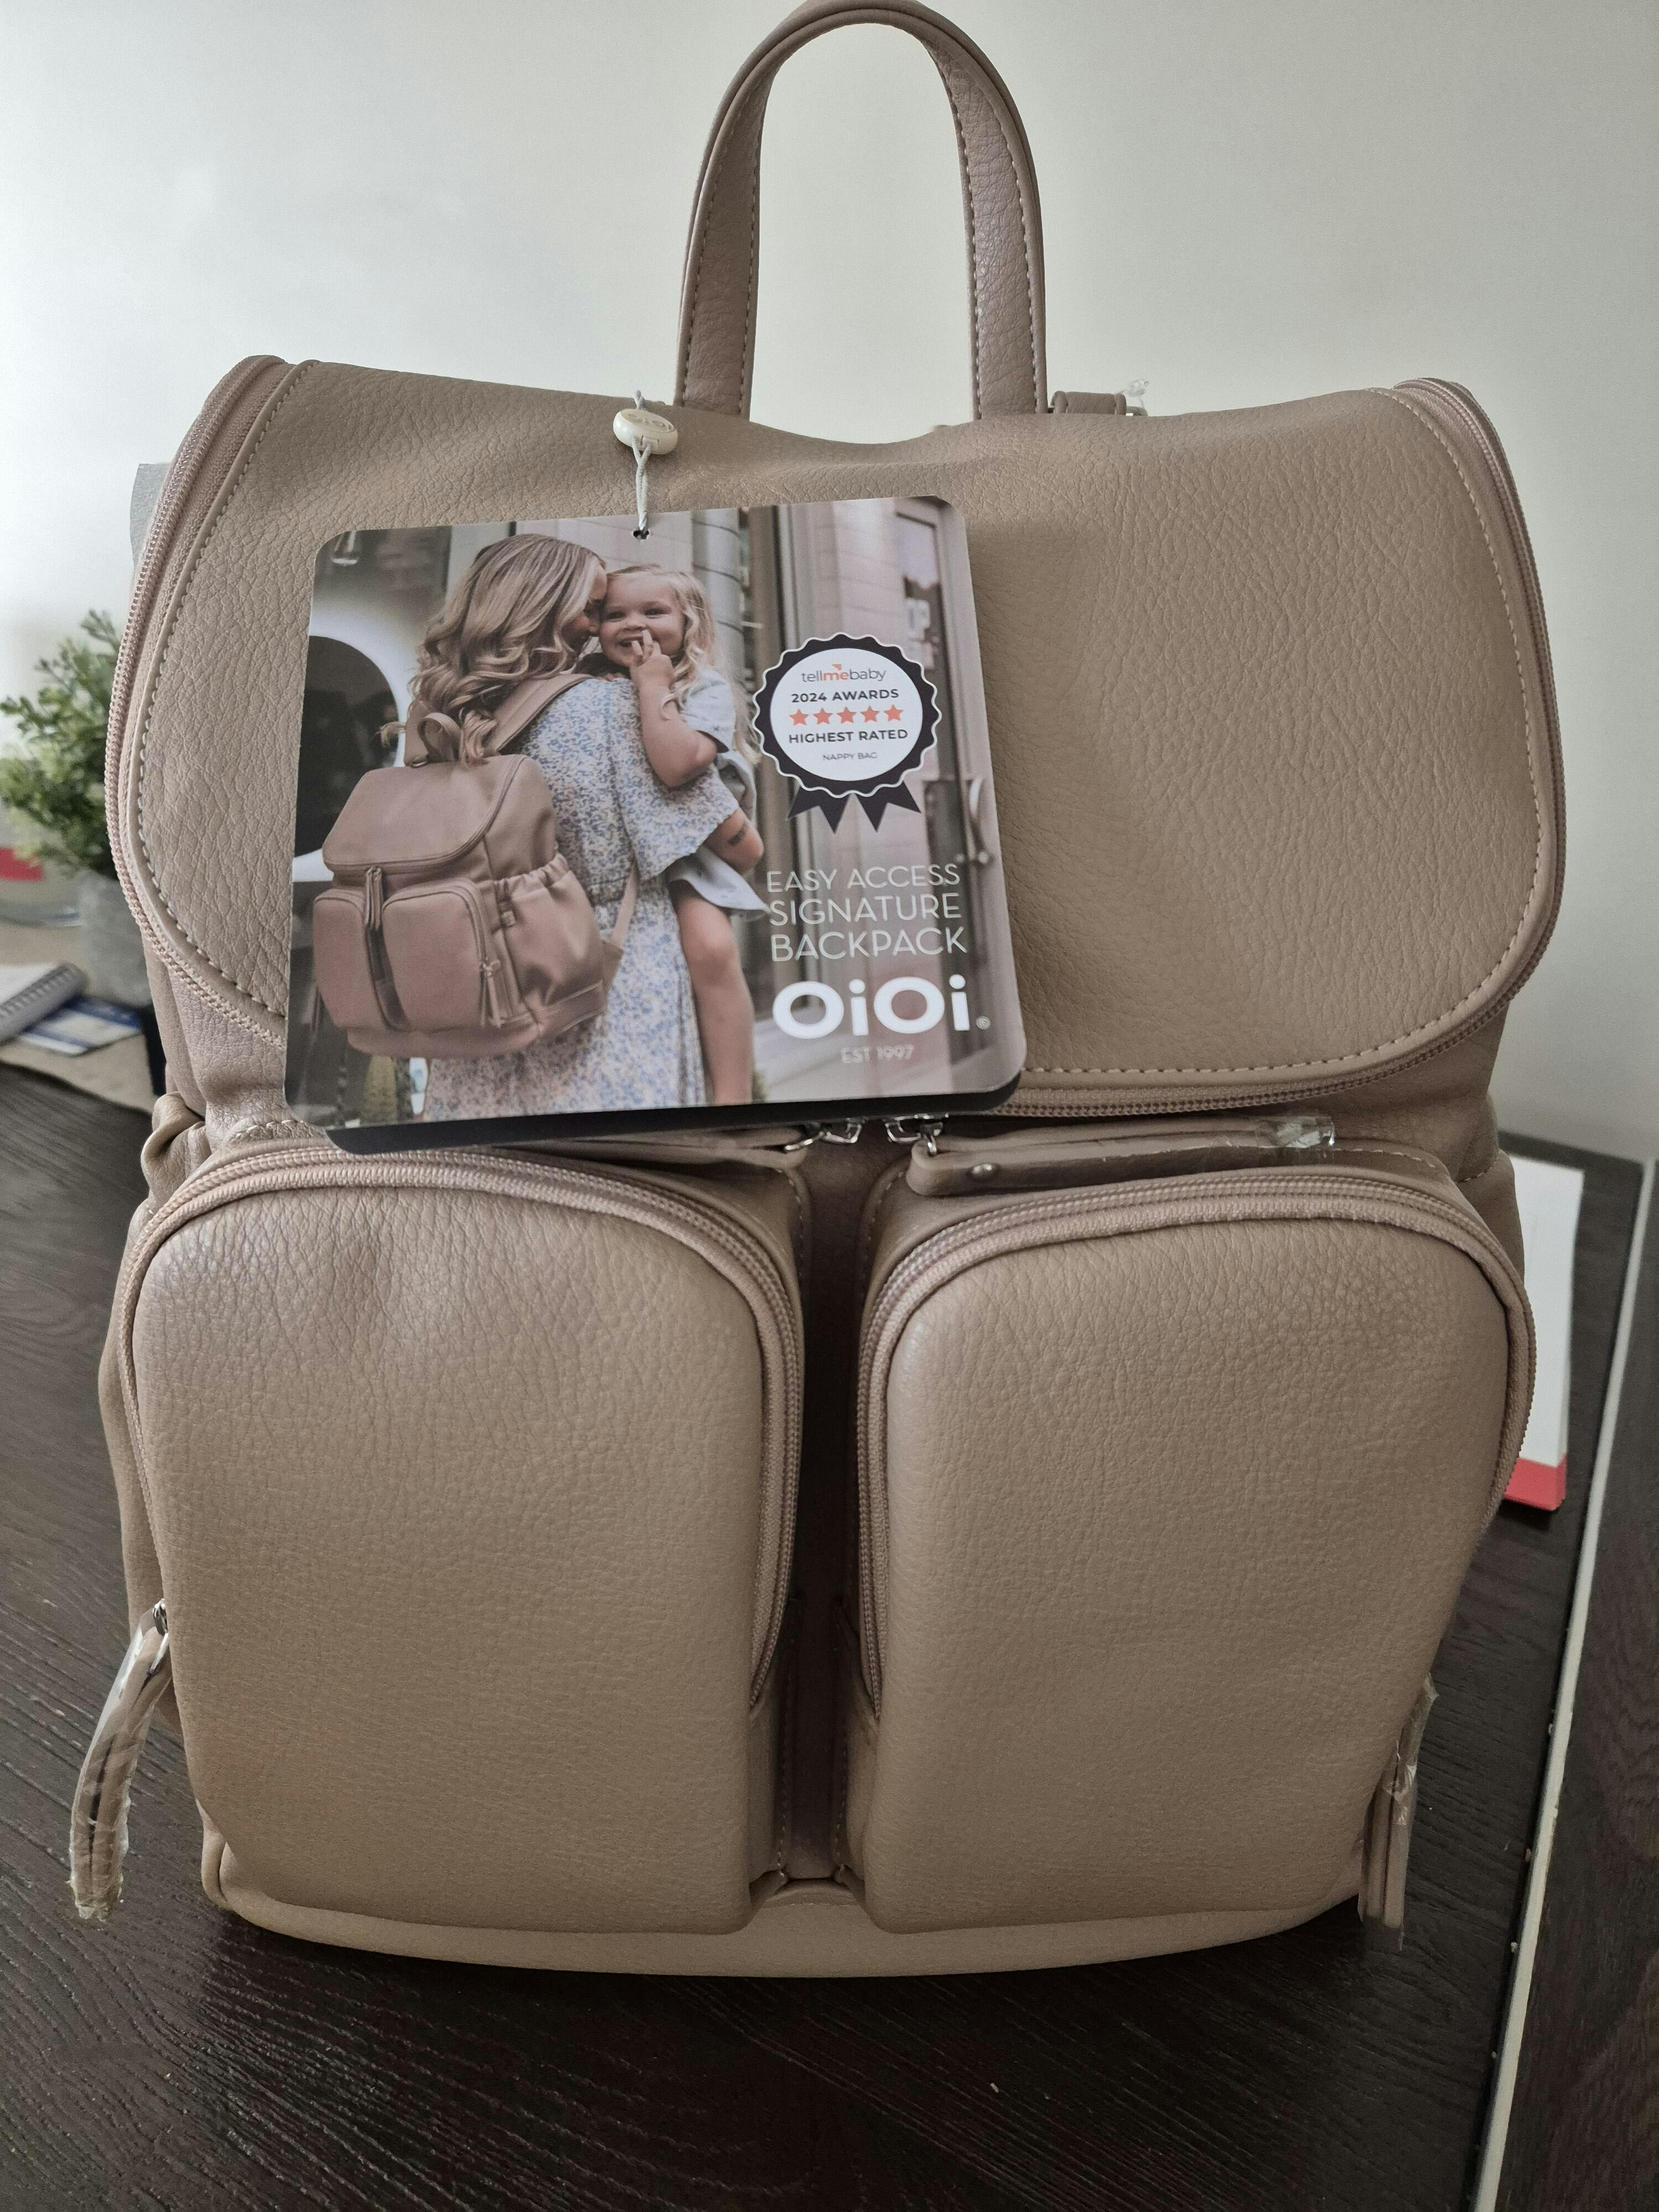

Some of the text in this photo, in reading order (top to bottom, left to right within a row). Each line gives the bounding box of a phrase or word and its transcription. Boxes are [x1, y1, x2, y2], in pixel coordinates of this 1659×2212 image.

[801, 668, 886, 683] tellmebaby
[791, 689, 899, 703] 2024 AWARDS
[789, 729, 908, 744] HIGHEST RATED
[766, 863, 961, 893] EASY ACCESS
[769, 893, 962, 926] SIGNATURE
[770, 926, 969, 962] BACKPACK
[841, 1044, 915, 1063] EST 1997
